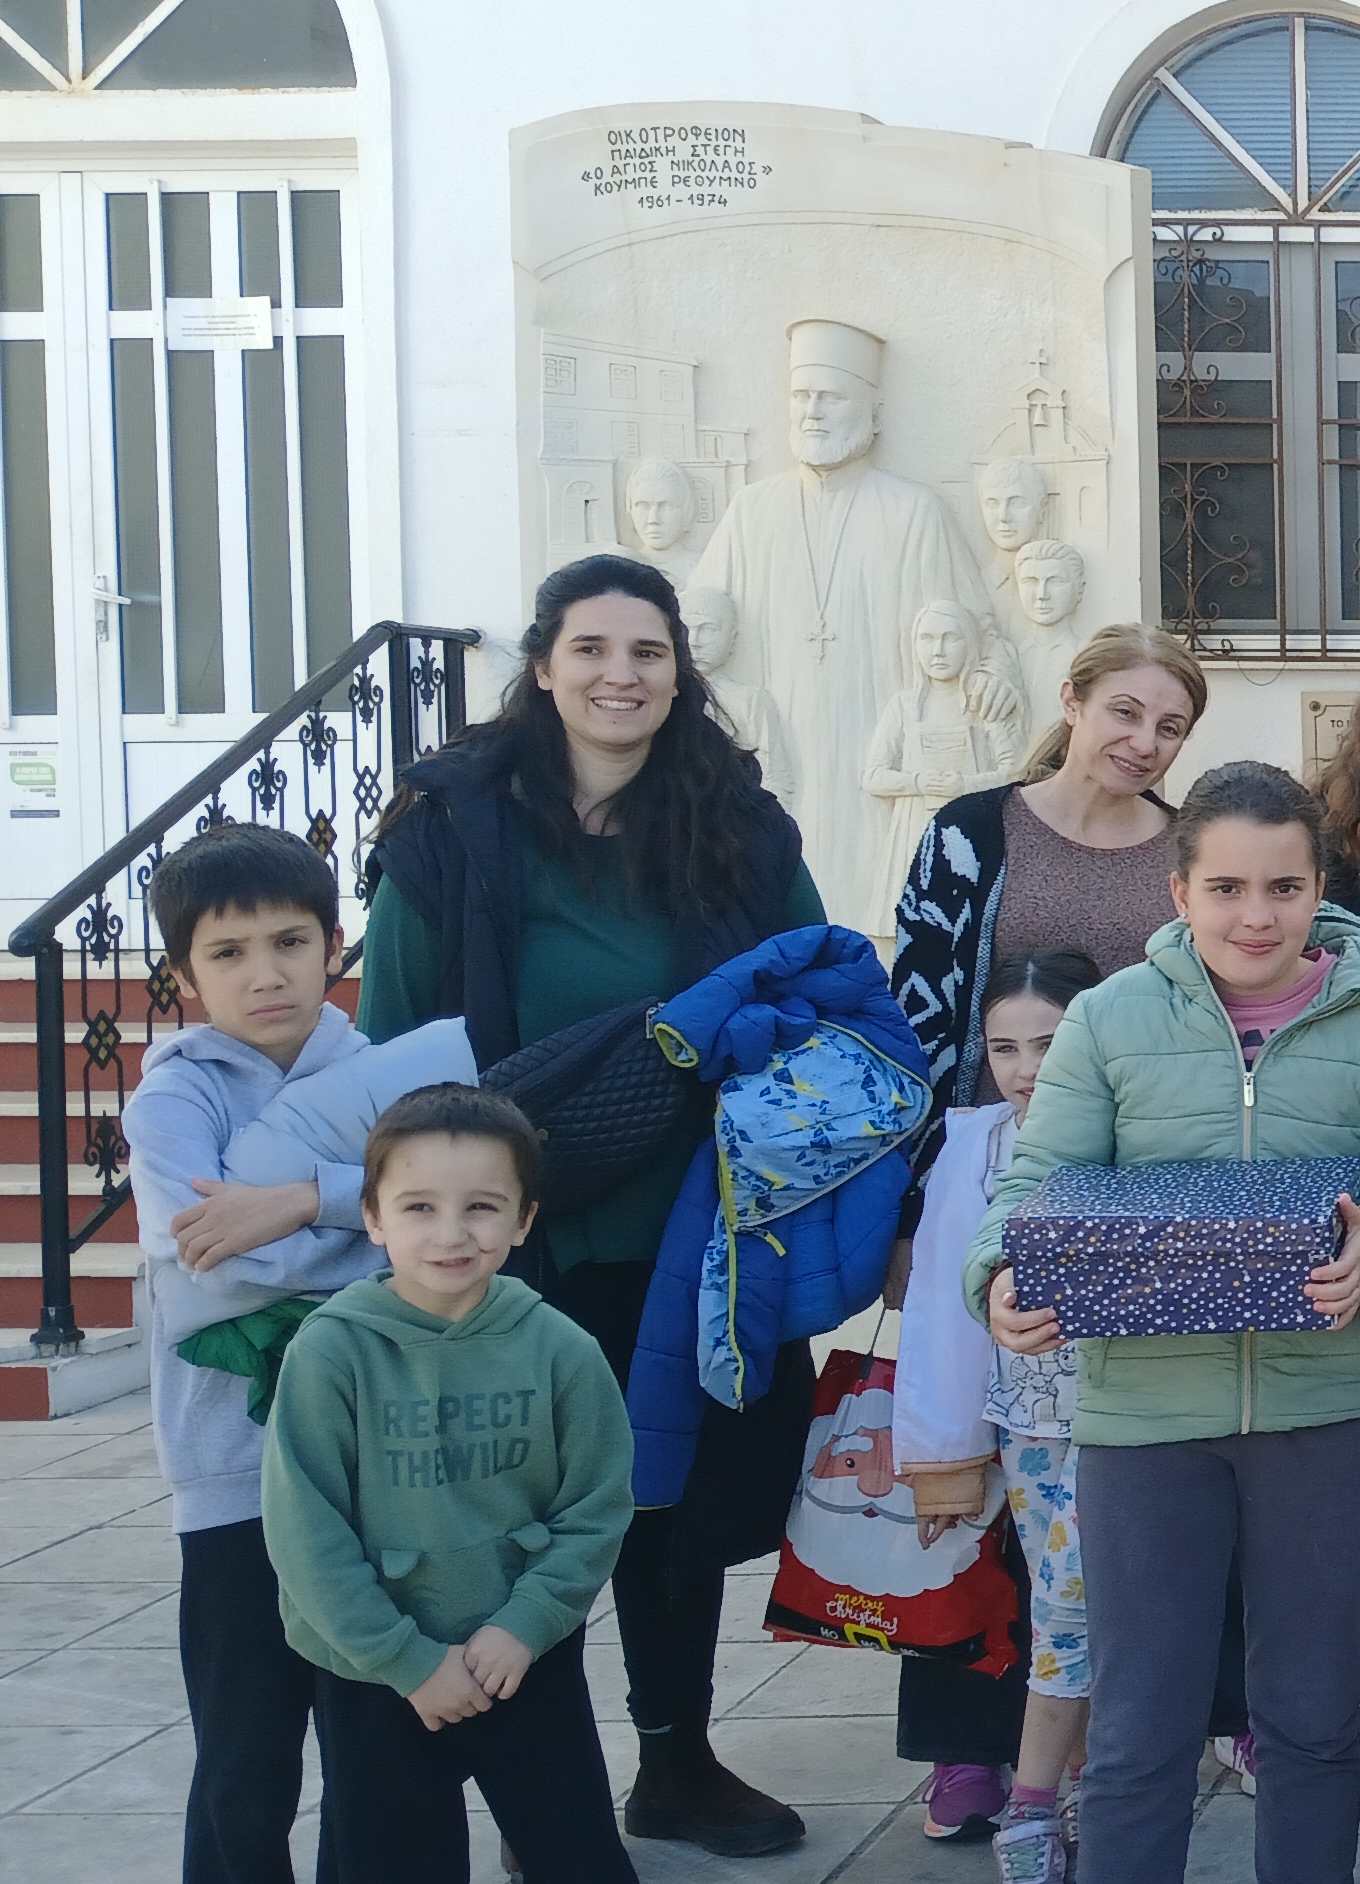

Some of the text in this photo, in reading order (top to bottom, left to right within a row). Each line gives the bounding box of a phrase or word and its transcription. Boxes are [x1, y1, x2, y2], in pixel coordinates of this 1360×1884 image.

[607, 126, 746, 146] ΟΙΚΟΤΡΟΦΕΙΟΝ
[611, 144, 745, 161] ΠΑΙΔΙΚΗ ΣΤΕΓΗ
[610, 160, 658, 178] ΑΓΙΟΣ
[594, 174, 758, 197] ΚΟΥΜΠΕ ΡΕΘΥΜΝΟ
[383, 1389, 537, 1439] REPECT
[441, 1437, 532, 1484] WILD
